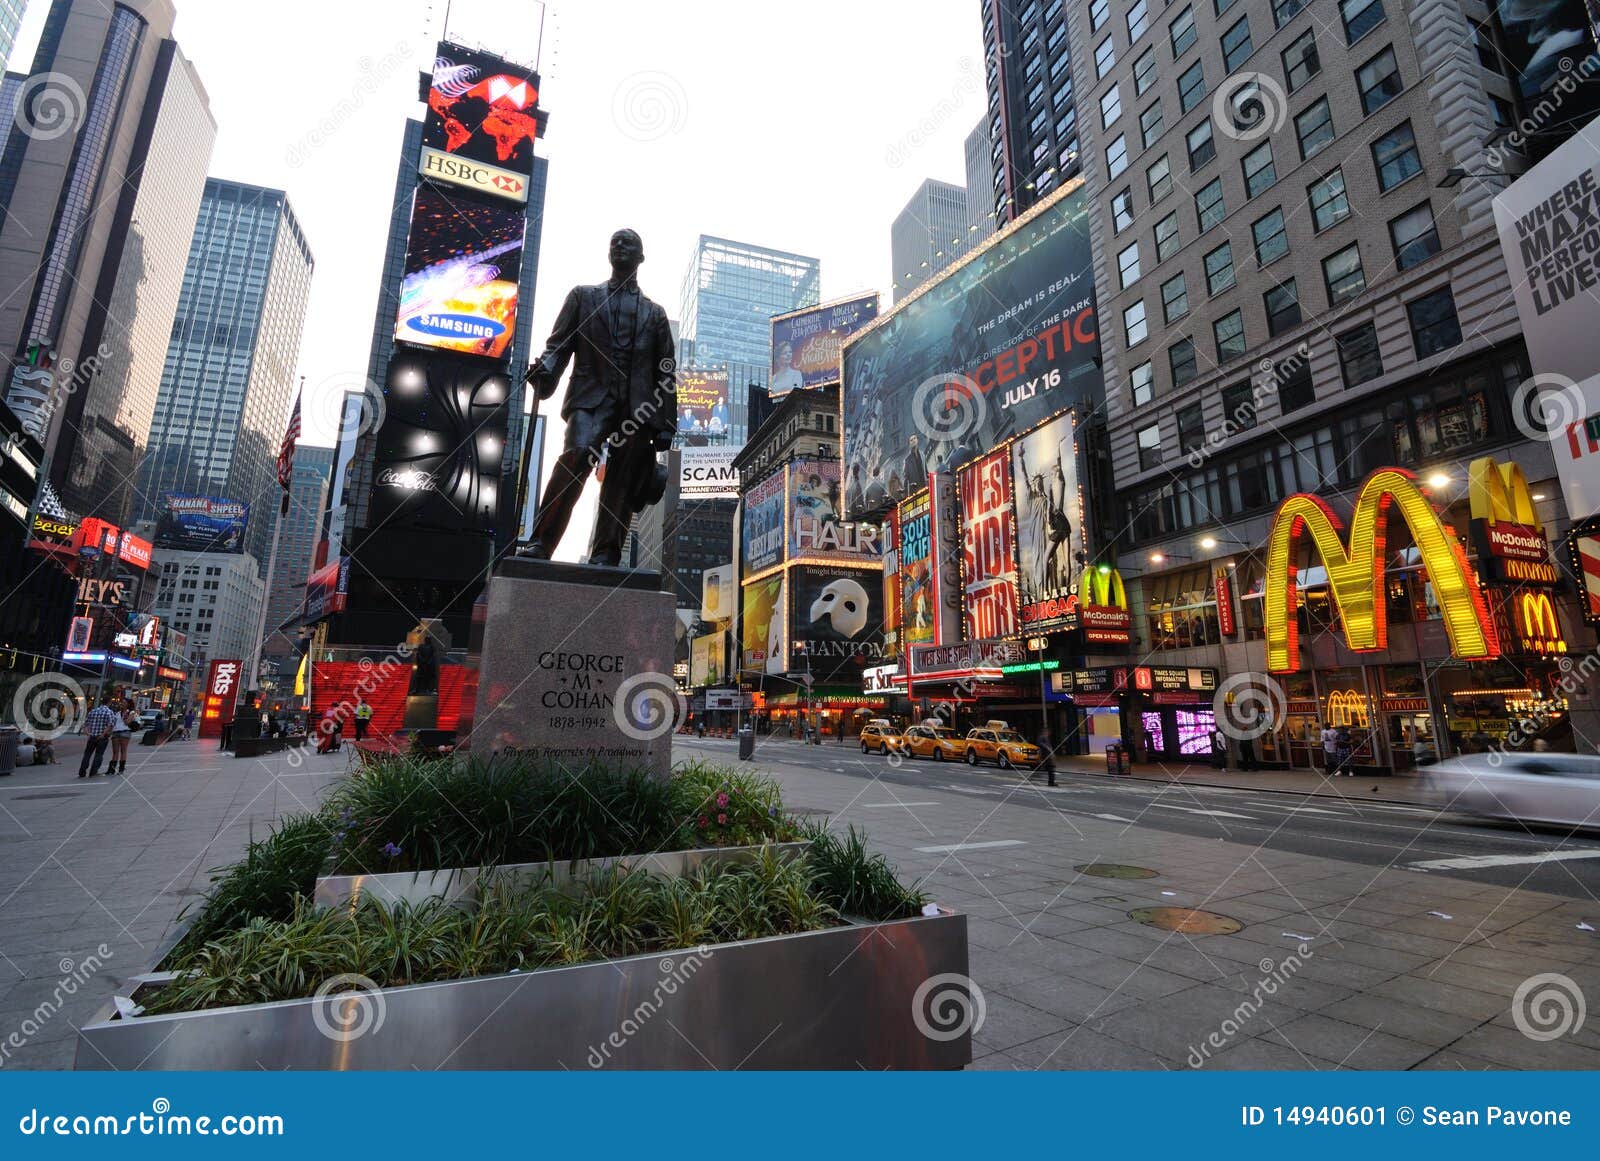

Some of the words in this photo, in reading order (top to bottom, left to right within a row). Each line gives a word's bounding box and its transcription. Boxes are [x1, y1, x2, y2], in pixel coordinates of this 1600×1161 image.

[426, 154, 489, 184] HSBC
[1515, 168, 1596, 238] WHERE
[978, 321, 995, 336] THE
[998, 298, 1032, 324] DREAM
[1036, 290, 1046, 303] IS
[1049, 272, 1081, 295] REAL.
[420, 312, 494, 338] SAMSUNG
[967, 356, 981, 368] THE
[983, 332, 1024, 360] DIRECTOR
[1026, 325, 1039, 337] OF
[1041, 313, 1060, 328] THE
[1063, 297, 1091, 318] DARK
[1001, 377, 1038, 409] JULY
[1042, 369, 1061, 390] 16
[682, 467, 736, 481] SCAM
[961, 452, 1011, 521] WEST
[174, 499, 208, 508] BANANA
[796, 519, 879, 554] HAIR
[964, 510, 1016, 586] SIDE
[1491, 531, 1547, 550] McDonald's
[1503, 546, 1541, 558] Restaurant
[806, 566, 830, 576] Tonight
[830, 567, 855, 578] belongs
[1083, 611, 1129, 621] McDonald's
[791, 639, 888, 659] PHANTOM
[539, 651, 624, 673] GEORGE
[213, 662, 237, 696] tkts
[572, 673, 591, 690] M
[541, 691, 616, 709] COHAN
